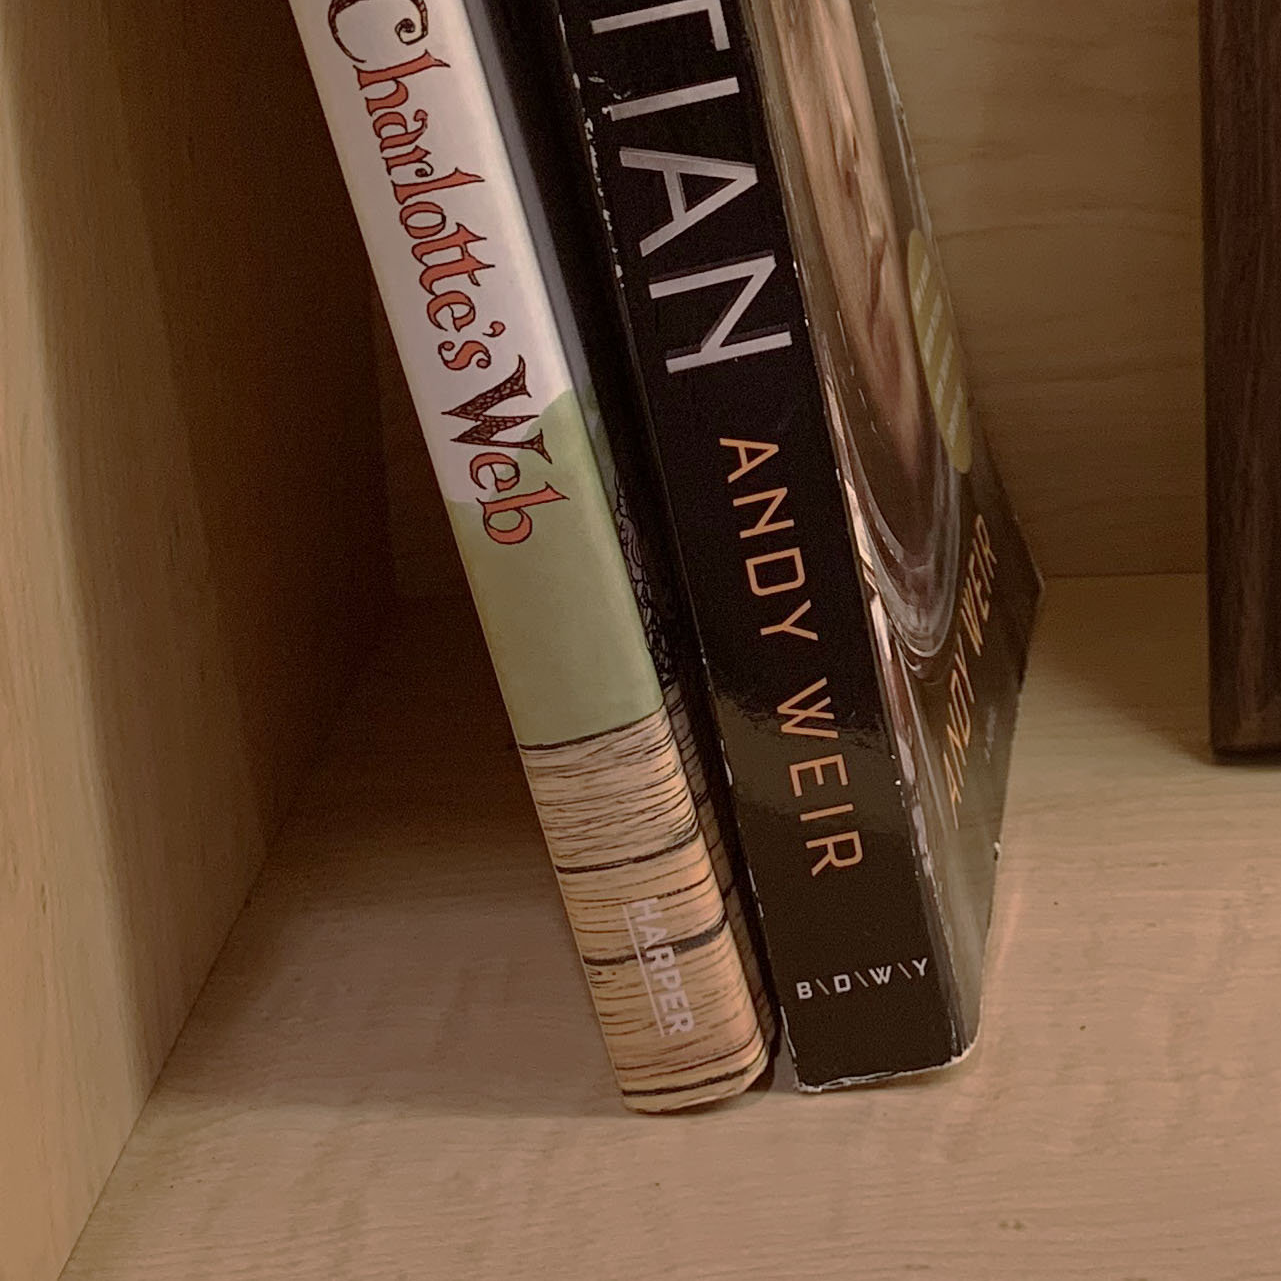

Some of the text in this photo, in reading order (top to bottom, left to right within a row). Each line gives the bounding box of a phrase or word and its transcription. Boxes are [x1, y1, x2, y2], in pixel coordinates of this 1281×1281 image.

[440, 354, 571, 545] Web
[719, 436, 864, 878] ANDY WEIR
[943, 513, 998, 831] ANDY WEIR
[630, 896, 695, 1037] HARPER
